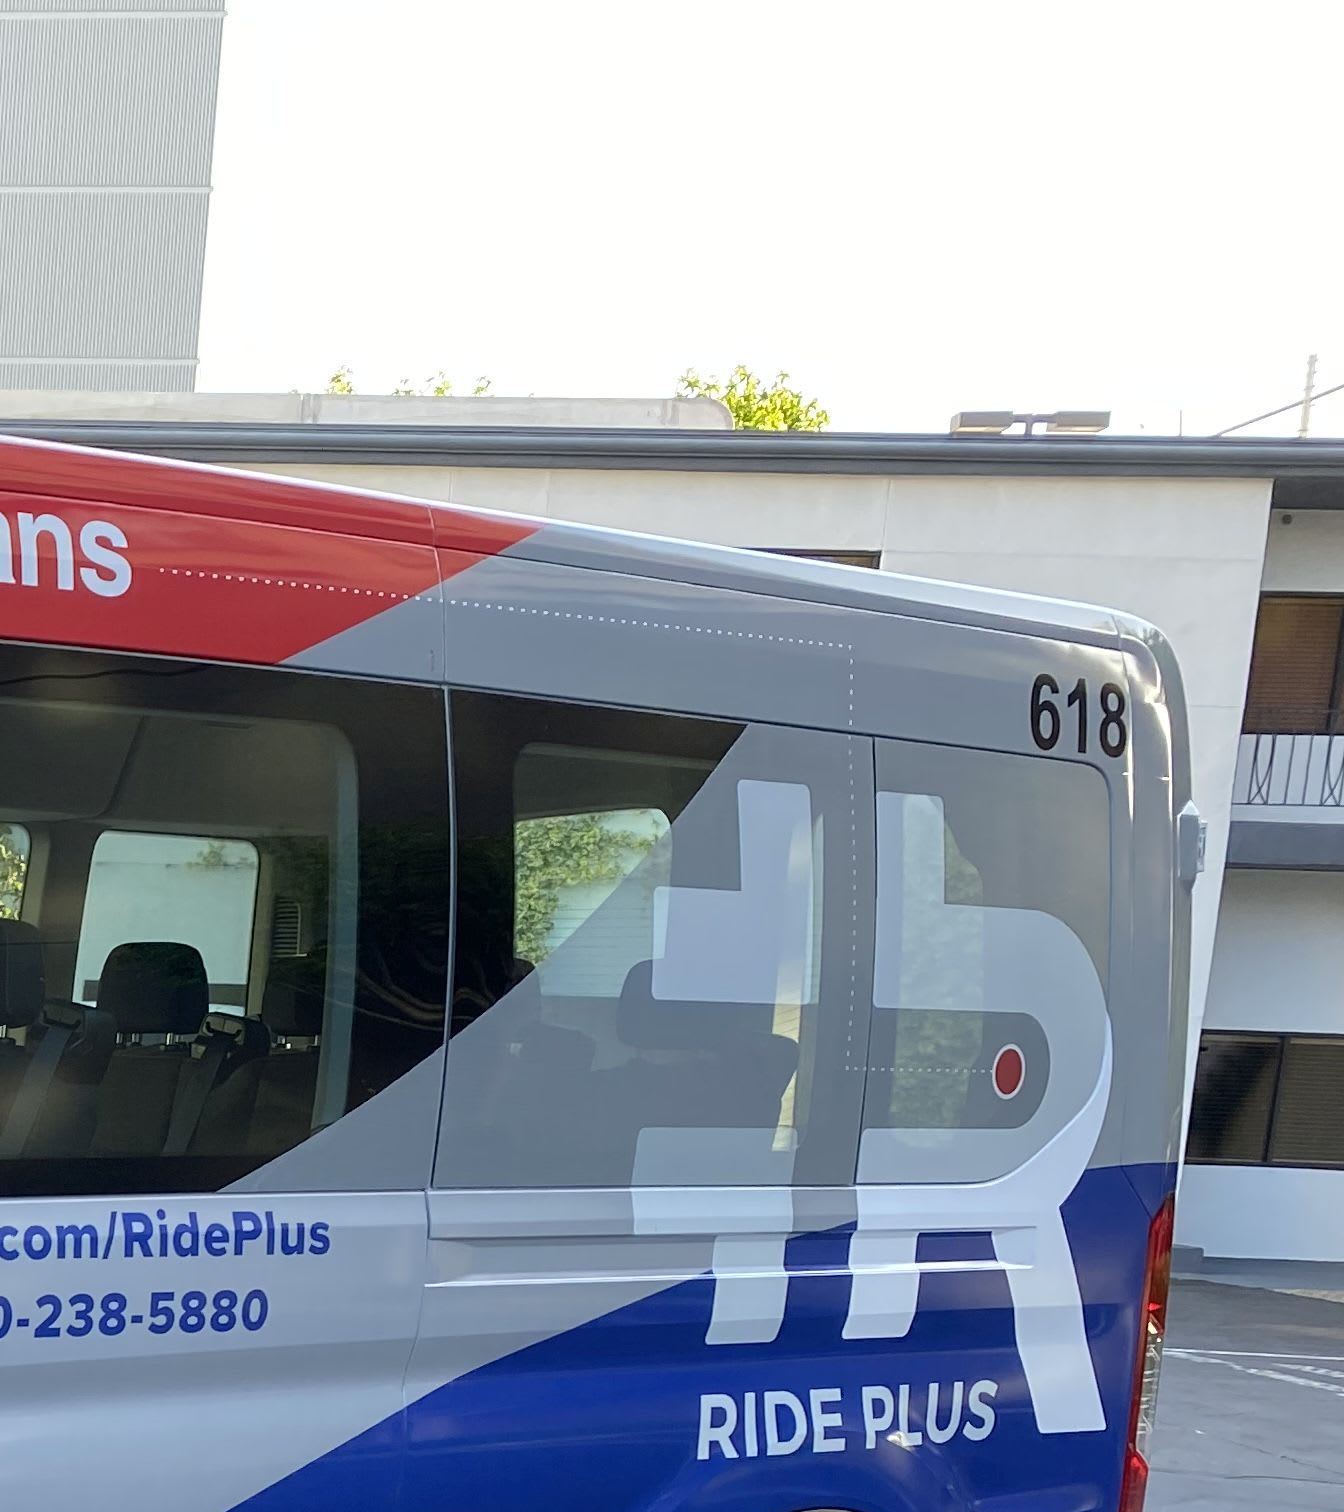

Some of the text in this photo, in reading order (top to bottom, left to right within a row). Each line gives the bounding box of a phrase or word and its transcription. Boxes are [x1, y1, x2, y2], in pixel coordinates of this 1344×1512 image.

[1030, 673, 1127, 757] 618
[697, 1379, 999, 1460] RIDE PLUS
